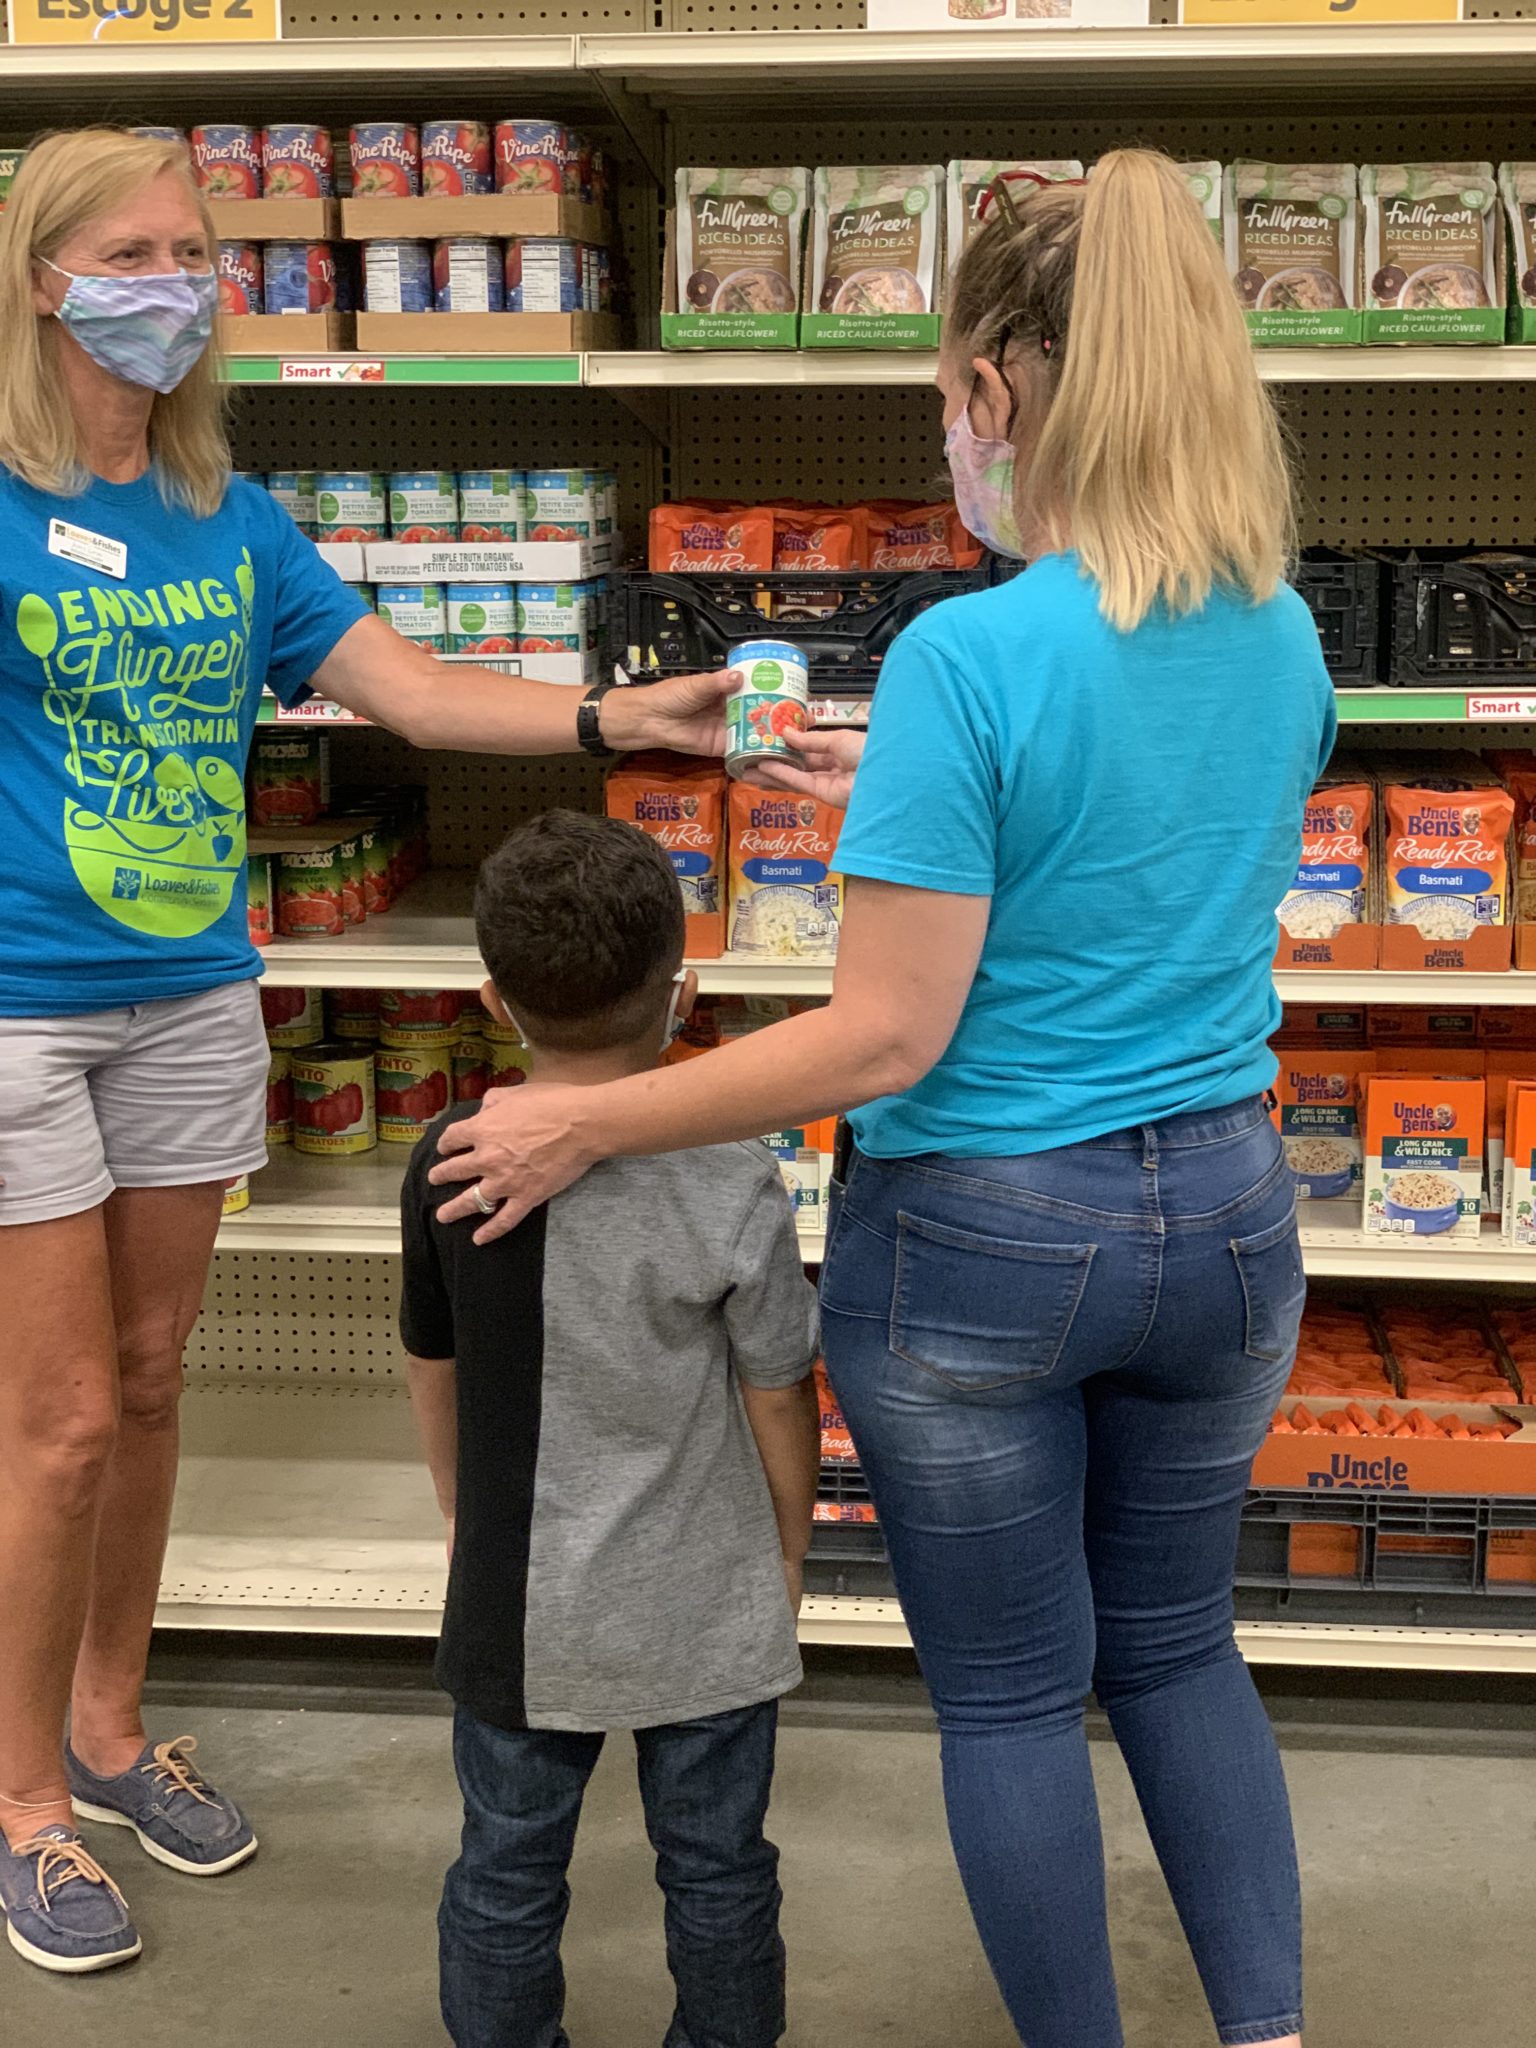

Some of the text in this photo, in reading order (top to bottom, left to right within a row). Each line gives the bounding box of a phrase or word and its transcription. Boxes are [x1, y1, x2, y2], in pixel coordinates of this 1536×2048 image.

[194, 143, 230, 168] Vine
[291, 138, 328, 168] Ripe
[381, 135, 417, 165] Ripe
[434, 135, 474, 163] Ripe
[501, 139, 541, 163] Vine
[698, 232, 785, 246] RICED IDEAS
[1244, 232, 1334, 246] RICED IDEAS
[1385, 229, 1479, 241] RICED IDEAS
[831, 236, 915, 255] RICED IDEAS
[219, 254, 256, 282] Ripe
[698, 319, 756, 328] Risotto-style
[839, 319, 896, 328] Risotto-style
[1261, 316, 1321, 325] Risotto-style
[1402, 313, 1462, 323] Risotto-style
[677, 329, 778, 338] RICED CAULIFLOWER!
[816, 330, 920, 338] RICED CAULIFLOWER!
[1249, 327, 1344, 336] CED CAULIFLOWER!
[1379, 324, 1485, 333] RICED CAULIFLOWER!
[285, 365, 331, 378] Smart
[691, 523, 727, 538] Uncle
[432, 552, 514, 562] SIMPLE TRUTH ORGANIC
[669, 551, 760, 571] Ready Rice
[873, 548, 928, 570] Ready
[423, 563, 446, 572] PETITE
[448, 563, 469, 572] DICED
[471, 562, 508, 572] TOMATOES
[510, 562, 524, 571] NSA
[58, 578, 237, 634] ENDING
[1472, 701, 1520, 713] Smart
[64, 749, 196, 822] Lives
[643, 793, 679, 806] Uncle
[761, 800, 797, 813] Uncle
[1420, 806, 1459, 820] Uncle
[677, 823, 714, 845] Rice
[739, 829, 831, 860] Ready Rice
[1330, 835, 1363, 859] Rice
[1393, 838, 1497, 868] Ready Rice
[761, 864, 802, 876] Basmati
[1298, 871, 1341, 882] Basmati
[1419, 873, 1463, 886] Basmati
[1301, 943, 1331, 953] Uncle
[1433, 948, 1464, 958] Uncle
[1290, 1072, 1328, 1088] Uncle
[1297, 1086, 1331, 1103] Ben's
[1317, 1108, 1338, 1116] GRAIN
[1394, 1102, 1434, 1119] Uncle
[1326, 1115, 1346, 1123] RICE
[1402, 1117, 1437, 1134] Ben's
[769, 1139, 790, 1147] RICE
[1400, 1140, 1445, 1148] LONG GRAIN
[1432, 1148, 1453, 1156] RICE
[801, 1192, 814, 1201] 10
[1463, 1202, 1476, 1212] 10
[1331, 1453, 1408, 1482] Uncle
